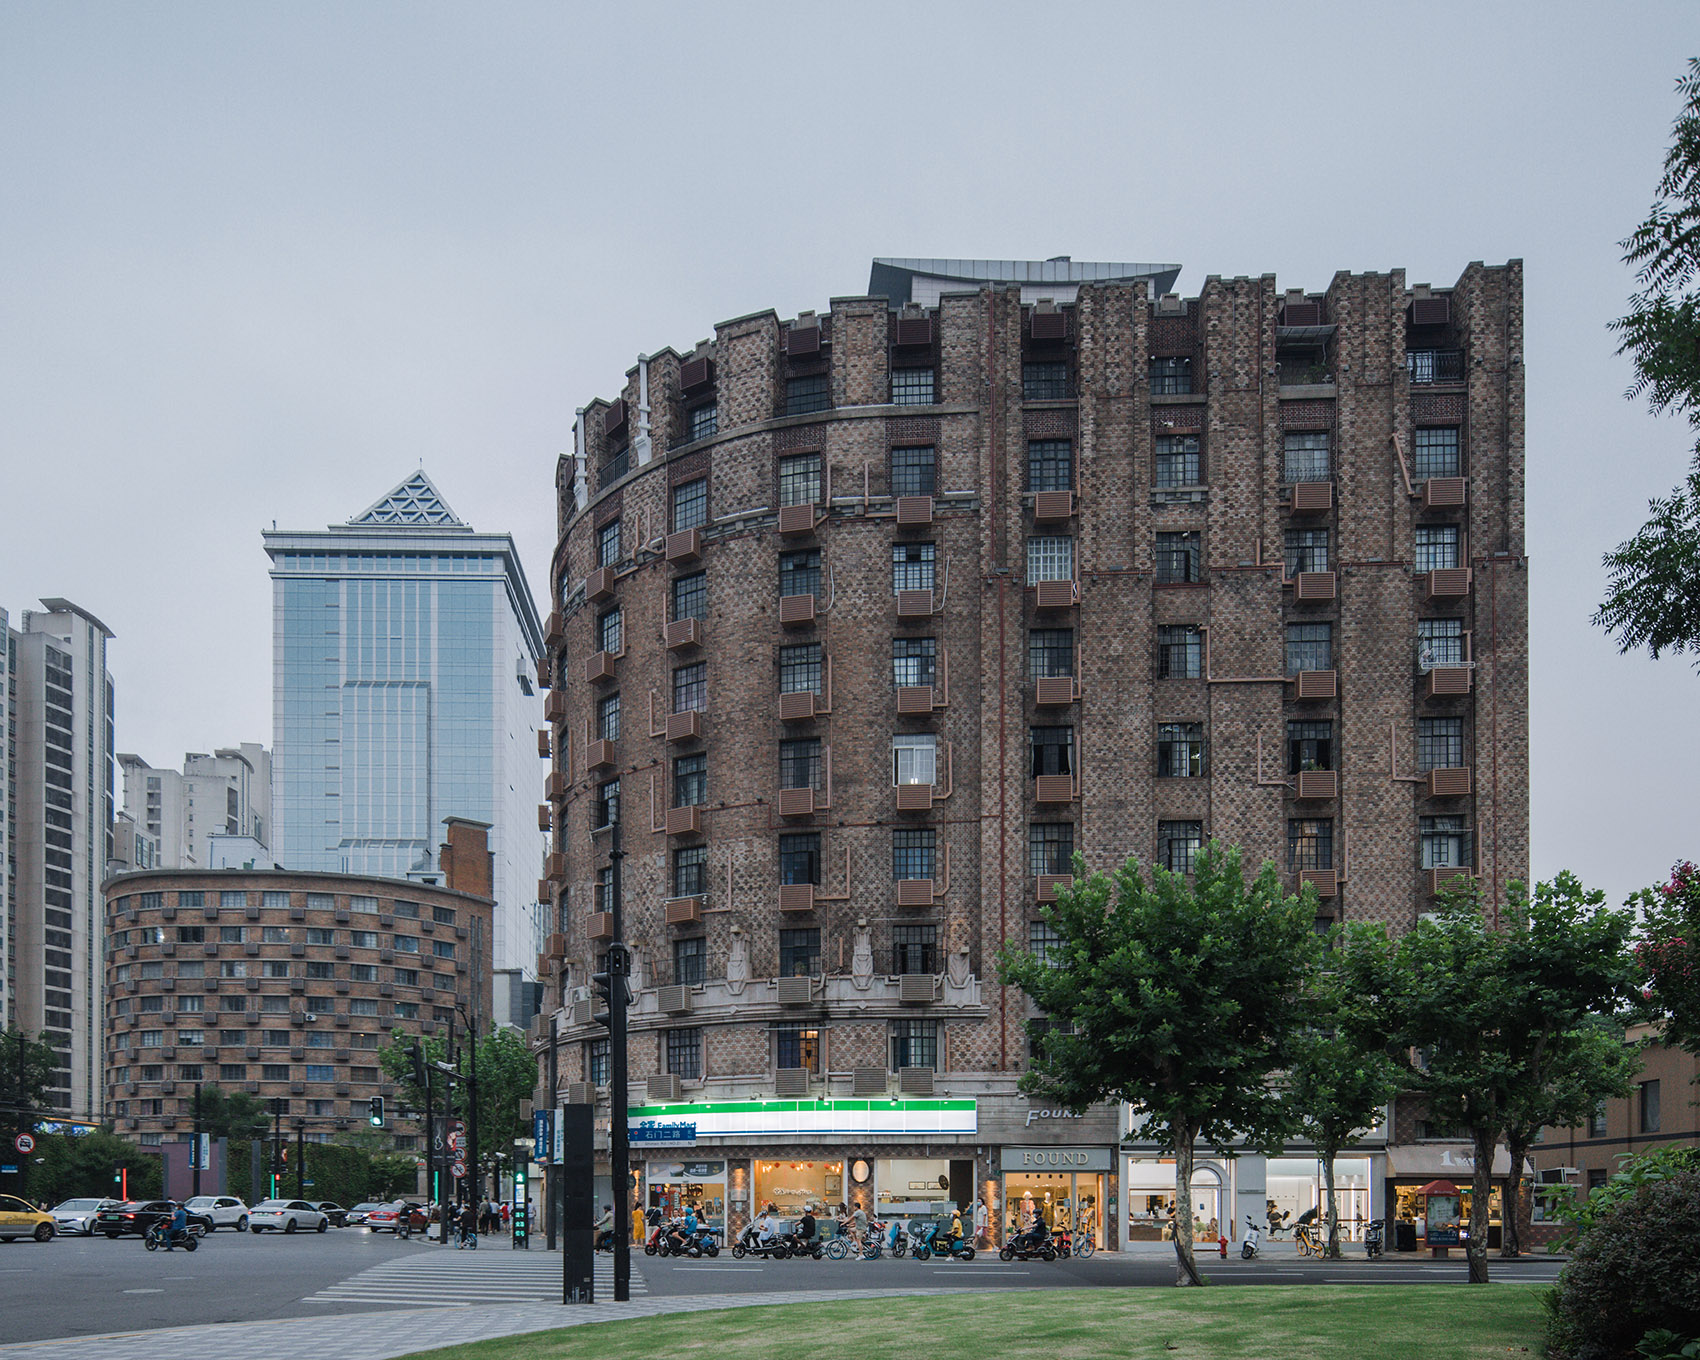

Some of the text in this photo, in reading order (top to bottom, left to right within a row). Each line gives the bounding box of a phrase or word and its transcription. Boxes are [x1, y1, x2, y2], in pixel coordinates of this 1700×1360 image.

[645, 1130, 681, 1139] 石门二路
[1023, 1152, 1089, 1165] FOUND
